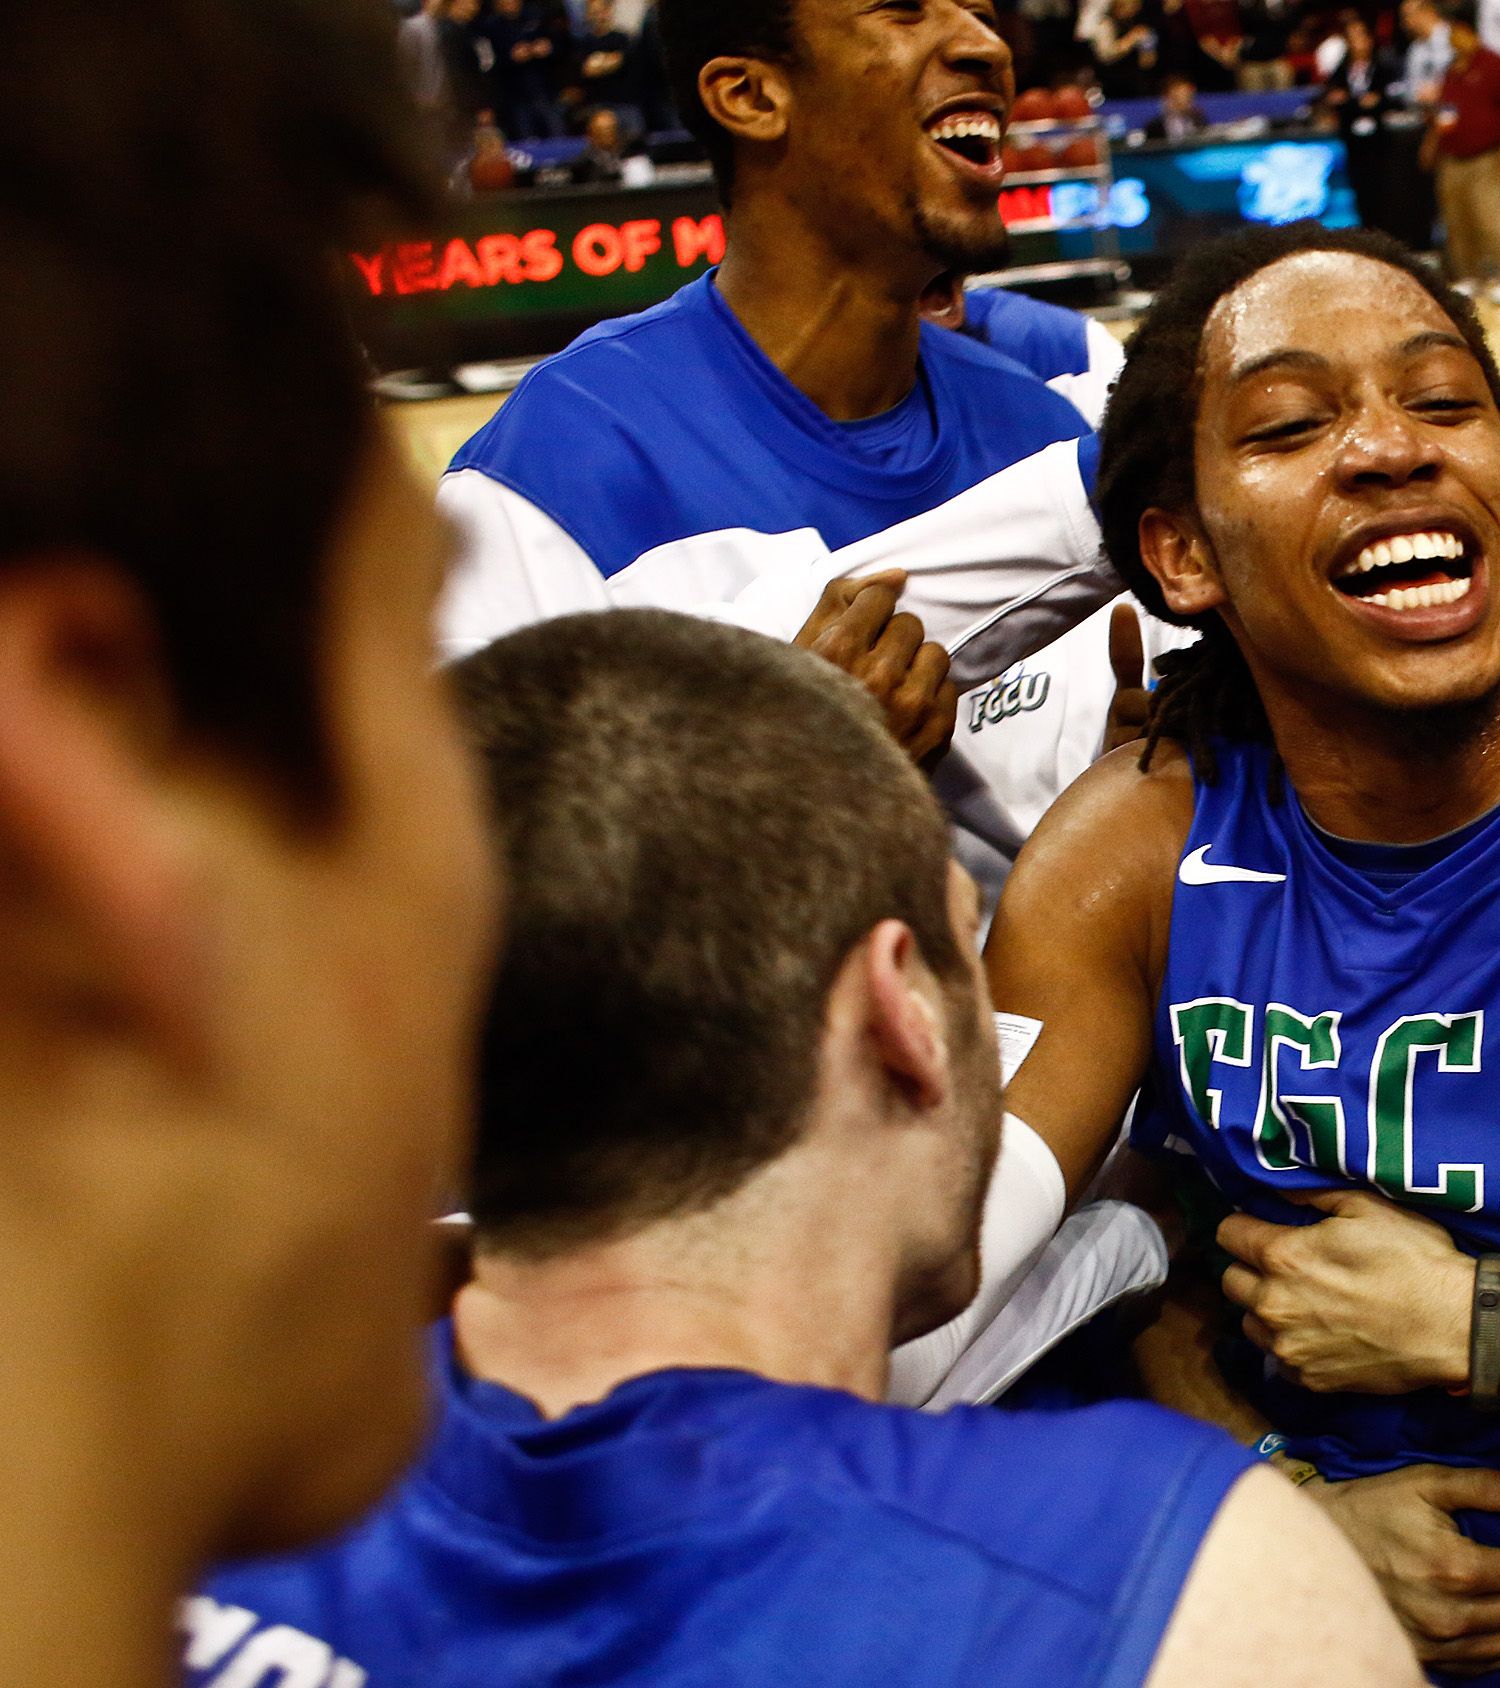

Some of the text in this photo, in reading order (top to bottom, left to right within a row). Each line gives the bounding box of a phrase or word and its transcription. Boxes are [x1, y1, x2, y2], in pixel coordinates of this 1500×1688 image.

[352, 228, 564, 296] YEARS
[571, 219, 661, 277] OF
[968, 671, 1051, 734] FGCU
